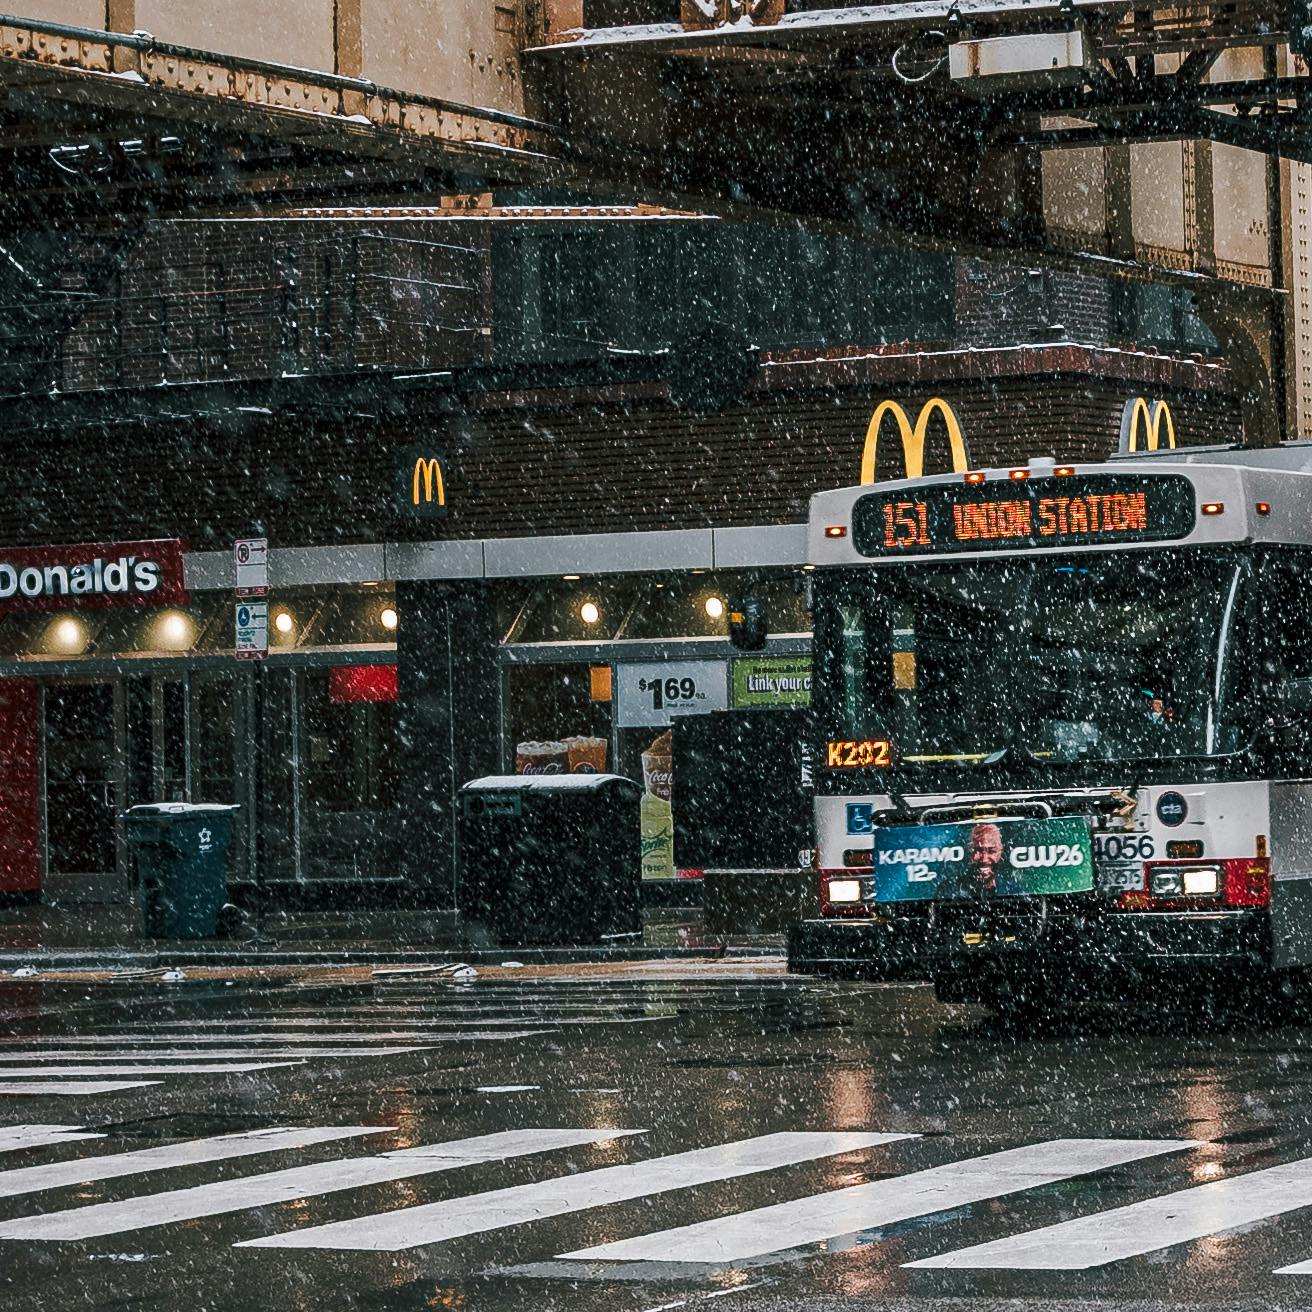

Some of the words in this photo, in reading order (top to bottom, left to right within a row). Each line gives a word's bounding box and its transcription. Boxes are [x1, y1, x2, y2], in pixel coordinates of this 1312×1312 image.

[882, 502, 931, 547] 151
[953, 500, 1031, 540] UNION
[1039, 492, 1146, 535] STATION
[748, 674, 773, 691] Link
[774, 678, 802, 694] your
[827, 741, 891, 767] K202
[1161, 803, 1183, 815] cta
[879, 845, 965, 865] KARAMO
